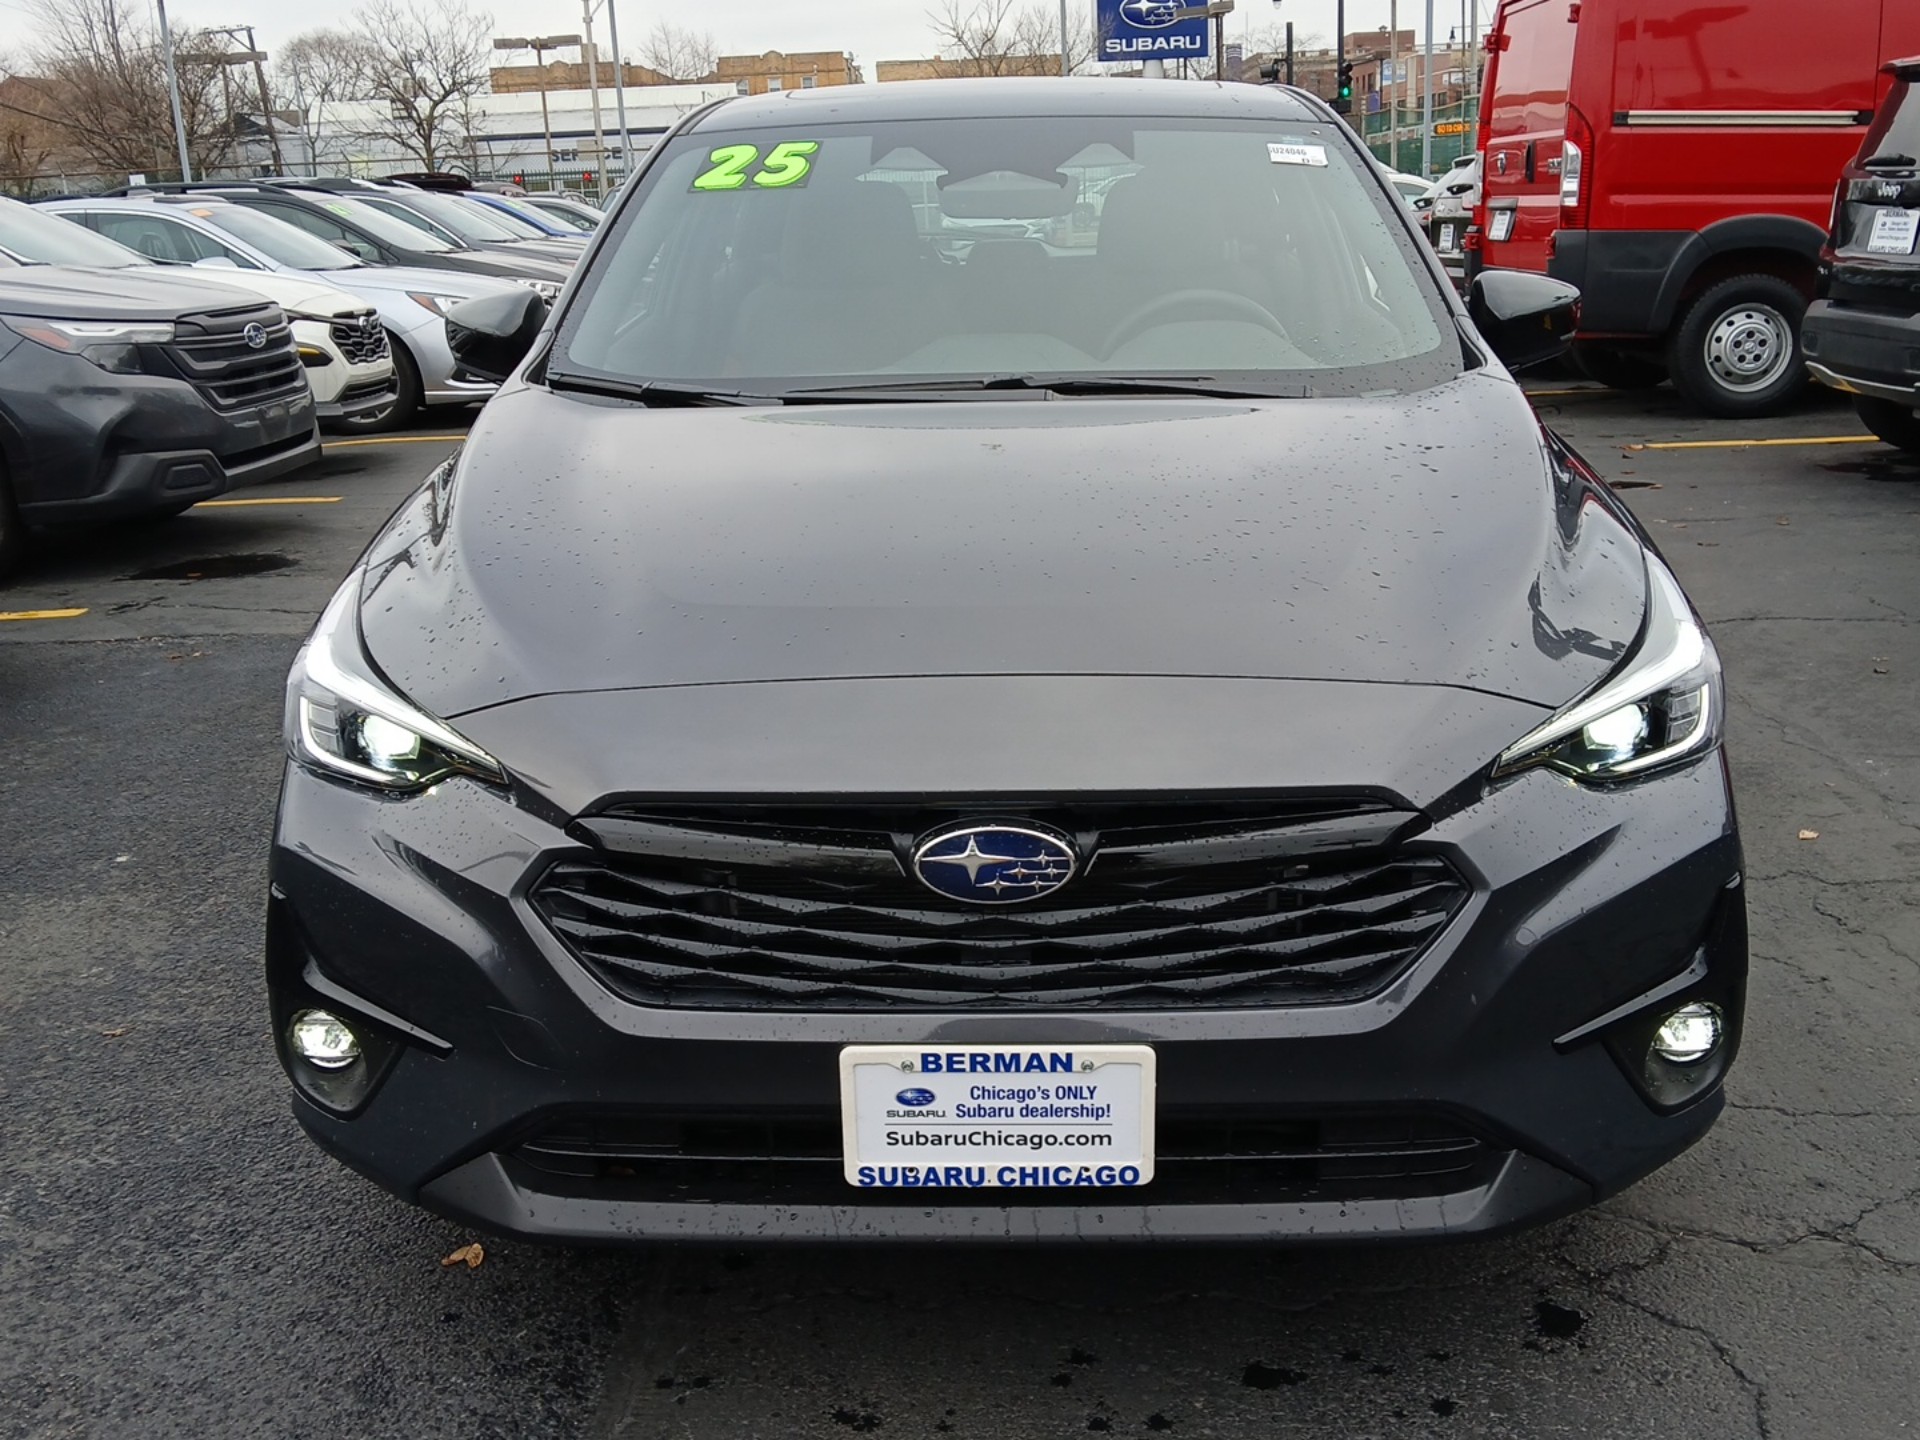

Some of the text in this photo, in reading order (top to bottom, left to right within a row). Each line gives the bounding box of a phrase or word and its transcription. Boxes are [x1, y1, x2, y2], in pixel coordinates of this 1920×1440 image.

[1105, 35, 1201, 53] SUBARU
[552, 146, 623, 162] SERCE
[693, 141, 818, 191] 25
[1878, 182, 1901, 199] Jeep
[920, 1053, 1073, 1073] BERMAN
[970, 1085, 1097, 1103] Chicago's ONLY
[886, 1110, 946, 1118] SUBARU
[956, 1104, 1111, 1120] Subaru dealership!
[886, 1131, 1112, 1150] SubaruChicago.com
[858, 1165, 1140, 1187] SUBARU CHICAGO
